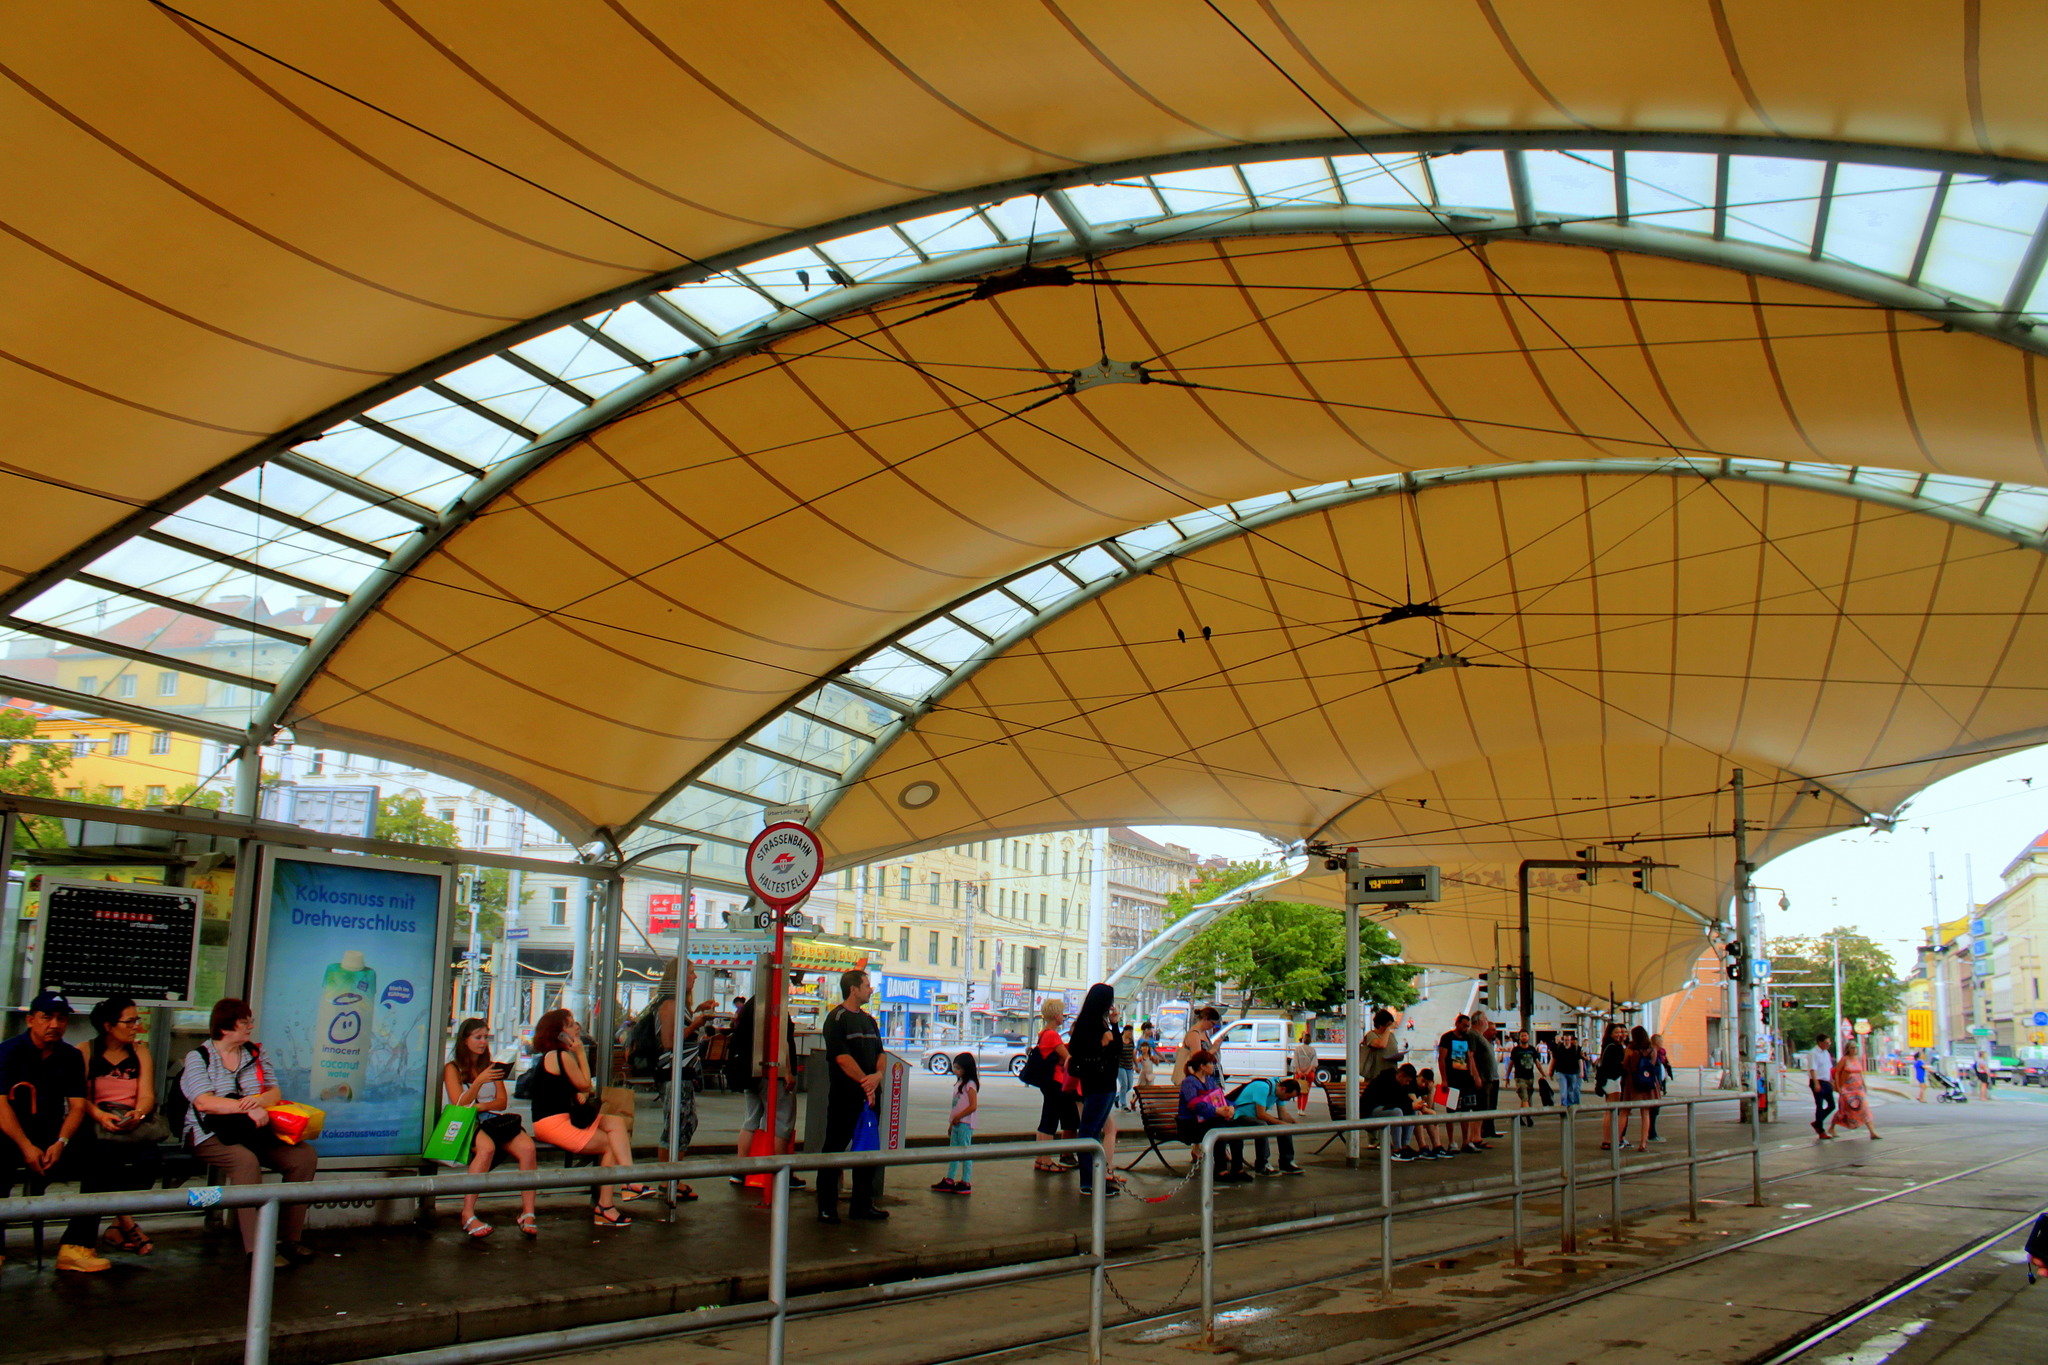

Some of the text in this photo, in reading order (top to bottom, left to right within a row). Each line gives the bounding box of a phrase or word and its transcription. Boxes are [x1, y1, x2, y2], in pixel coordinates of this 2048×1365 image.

[757, 833, 812, 861] STRASSENBAHN
[759, 869, 809, 893] HALTESTELLE
[295, 884, 416, 910] Kokosnuss mit
[291, 908, 416, 933] Drehverschluss
[760, 912, 769, 927] 6
[790, 912, 802, 927] 18
[1754, 963, 1768, 977] U
[322, 1045, 361, 1056] innocent
[320, 1060, 360, 1070] coconut
[327, 1070, 350, 1079] water
[321, 1129, 399, 1140] Kokosnusswasser
